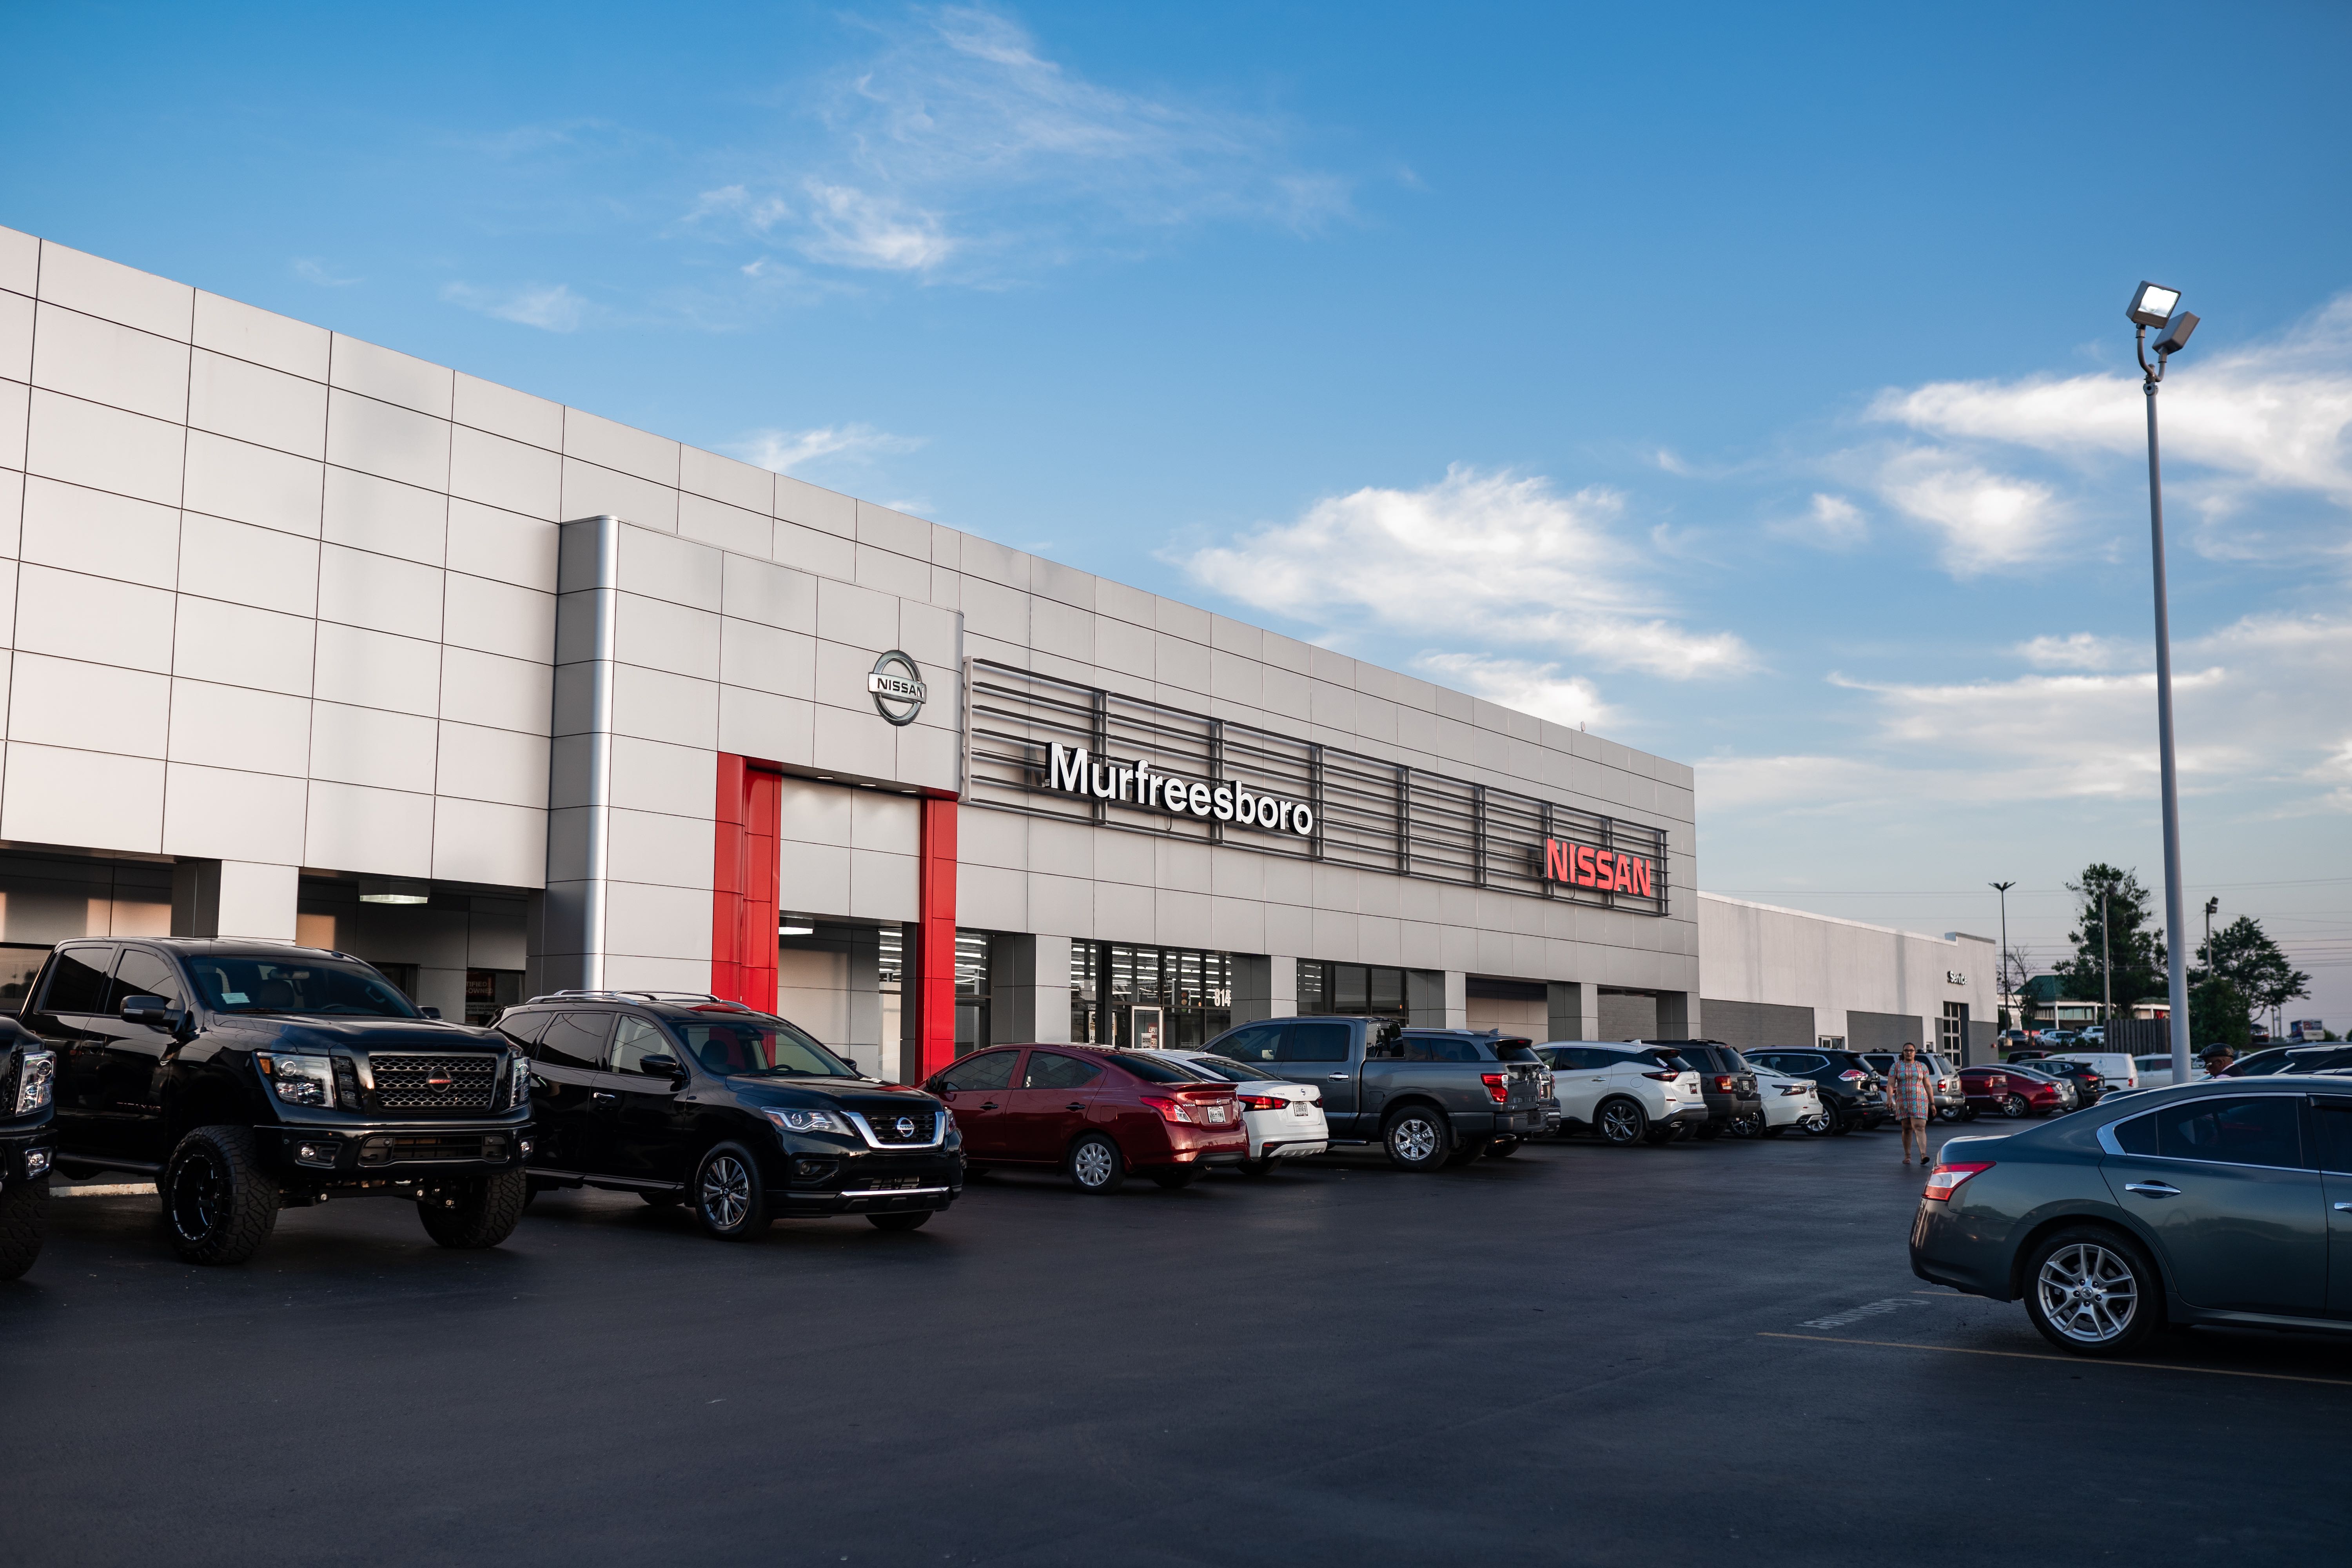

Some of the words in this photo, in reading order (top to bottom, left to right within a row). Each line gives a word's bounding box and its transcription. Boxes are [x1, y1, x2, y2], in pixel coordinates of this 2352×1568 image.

[877, 677, 924, 698] NISSAN
[1050, 741, 1313, 835] Murfreesboro
[1547, 838, 1650, 897] NISSAN
[1949, 970, 1967, 985] Service
[1214, 988, 1231, 1007] 814
[1388, 1126, 1399, 1159] GENERAL
